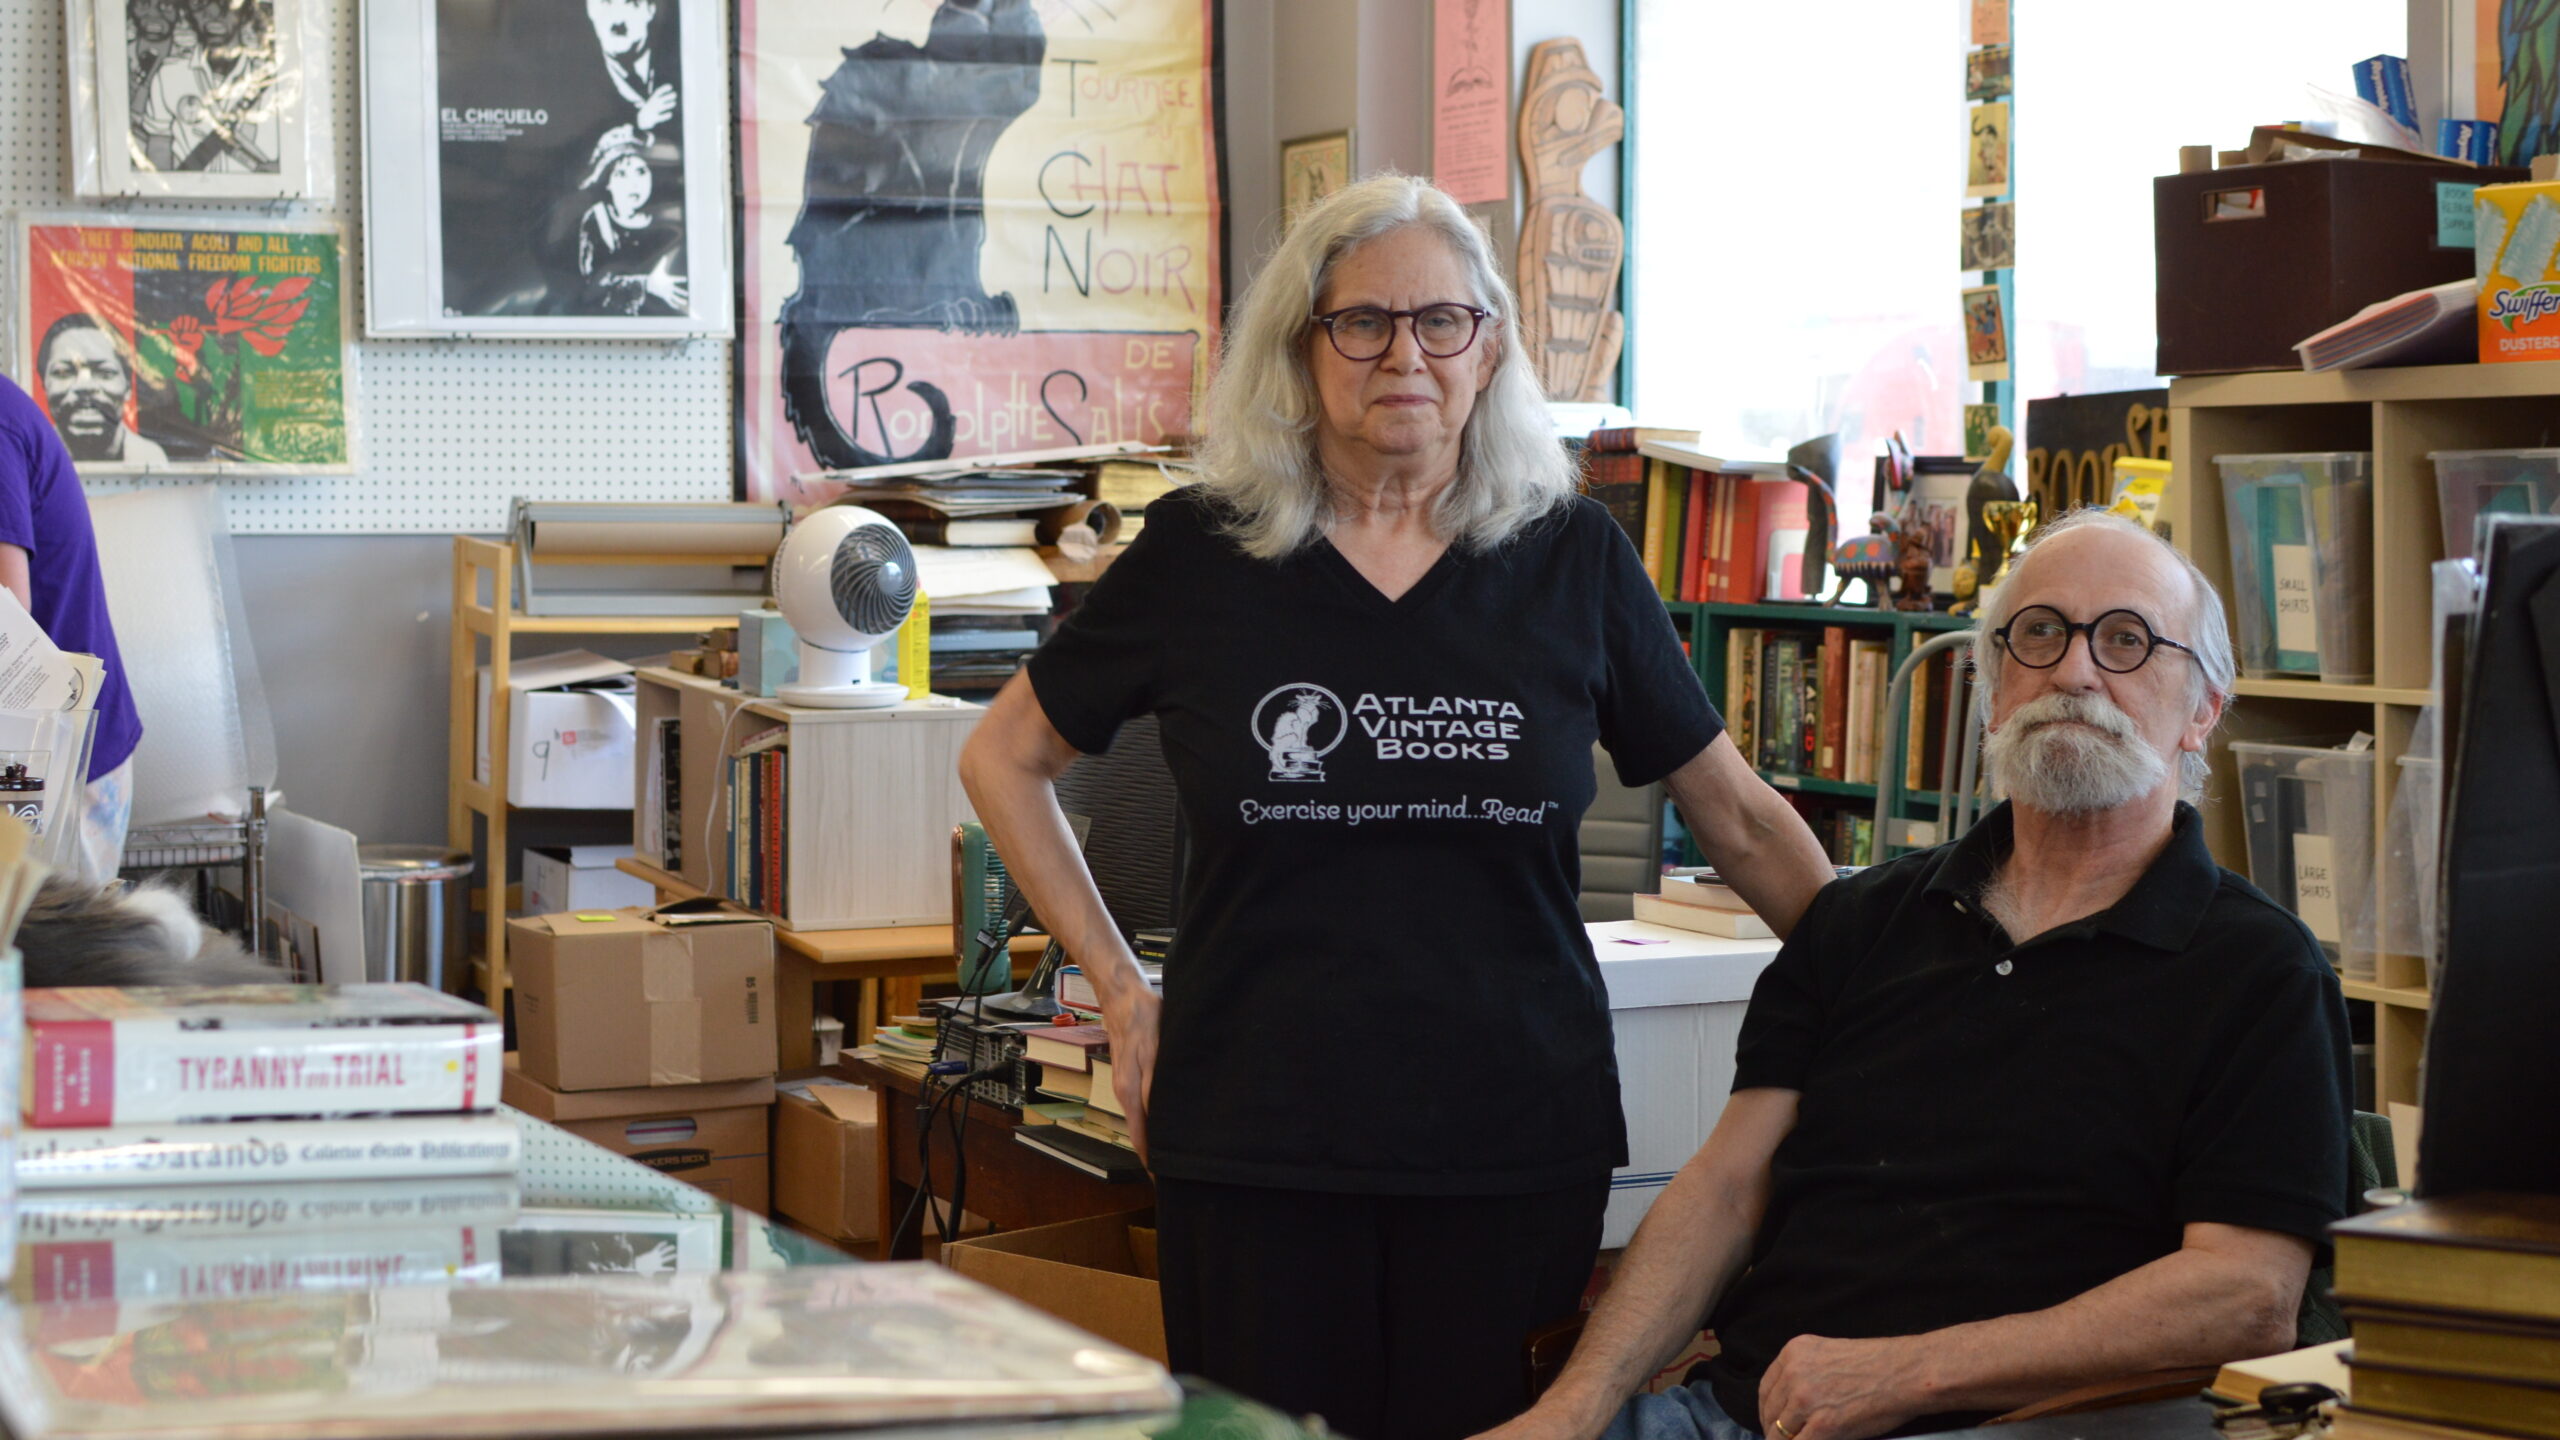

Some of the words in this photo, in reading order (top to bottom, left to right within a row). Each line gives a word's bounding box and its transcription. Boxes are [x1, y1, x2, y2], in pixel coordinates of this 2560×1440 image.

[441, 107, 462, 123] EL
[465, 108, 549, 125] CHICUELO
[1039, 144, 1181, 237] CHAT
[121, 231, 183, 251] SUNDIATA
[191, 232, 231, 251] ACOLI
[236, 233, 263, 253] AND
[266, 234, 290, 254] ALL
[118, 251, 181, 271] NATIONAL
[188, 252, 252, 273] FREEDOM
[258, 254, 322, 274] FIGHTERS
[1044, 225, 1198, 314] NOIR
[1125, 339, 1176, 370] DE
[2499, 335, 2560, 352] DUSTERS
[1352, 693, 1525, 720] ATLANTA
[1358, 716, 1521, 740] VINTAGE
[1376, 738, 1510, 760] BOOKS
[1239, 799, 1341, 825] Exercise
[1347, 803, 1402, 826] your
[178, 1057, 307, 1091] TYRANNY
[332, 1053, 406, 1087] TRIAL
